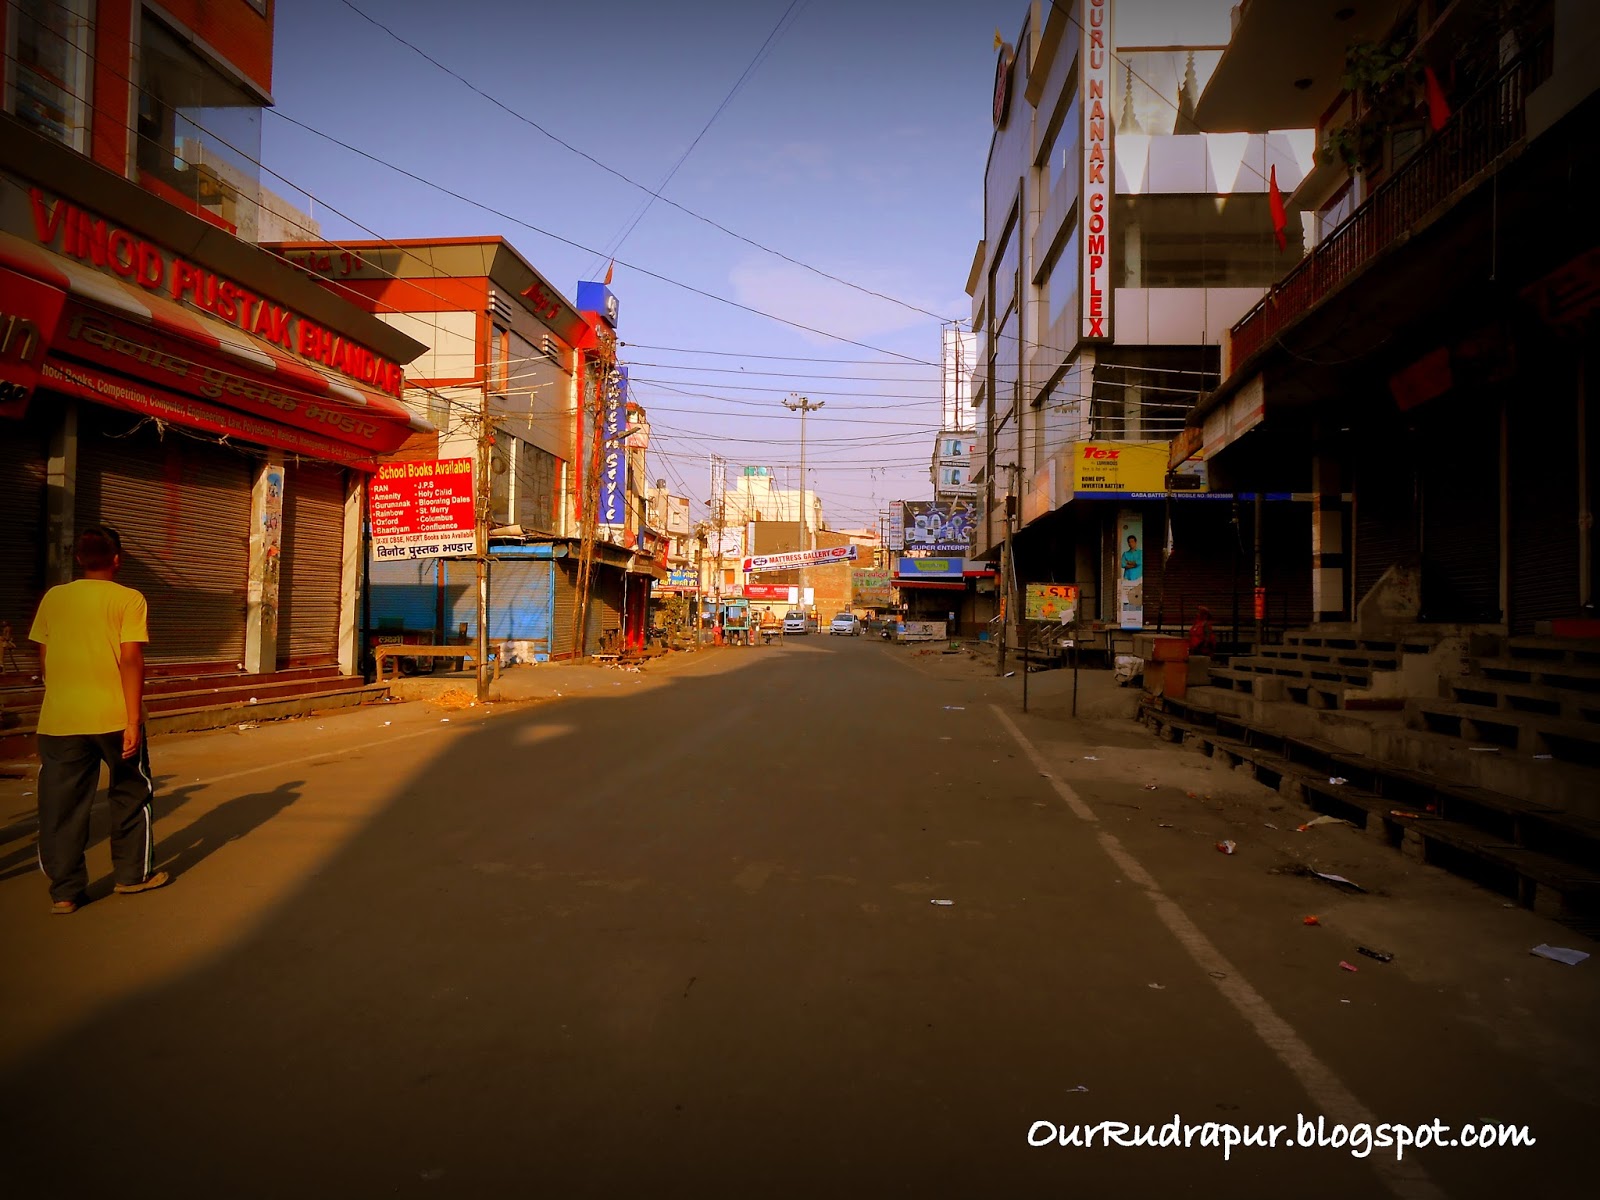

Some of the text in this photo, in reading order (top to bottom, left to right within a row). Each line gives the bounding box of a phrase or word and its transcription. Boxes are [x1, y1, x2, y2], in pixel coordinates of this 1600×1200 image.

[1089, 79, 1105, 184] NANAK
[1088, 193, 1105, 337] COMPLEX
[29, 187, 401, 398] VINOD PUSTAK BHANDAR
[97, 379, 148, 407] Competition,
[149, 395, 185, 416] Computer,
[1083, 447, 1120, 459] Tez
[379, 461, 471, 480] School Books Available
[418, 490, 433, 498] Holy
[605, 453, 618, 520] Style
[374, 492, 401, 501] Amenity
[375, 509, 404, 518] Rainbow
[375, 518, 399, 526] Oxford
[377, 542, 473, 559] विनोद पुस्तक भण्डार
[768, 553, 802, 563] MATTRESS
[803, 549, 831, 560] GALLERY
